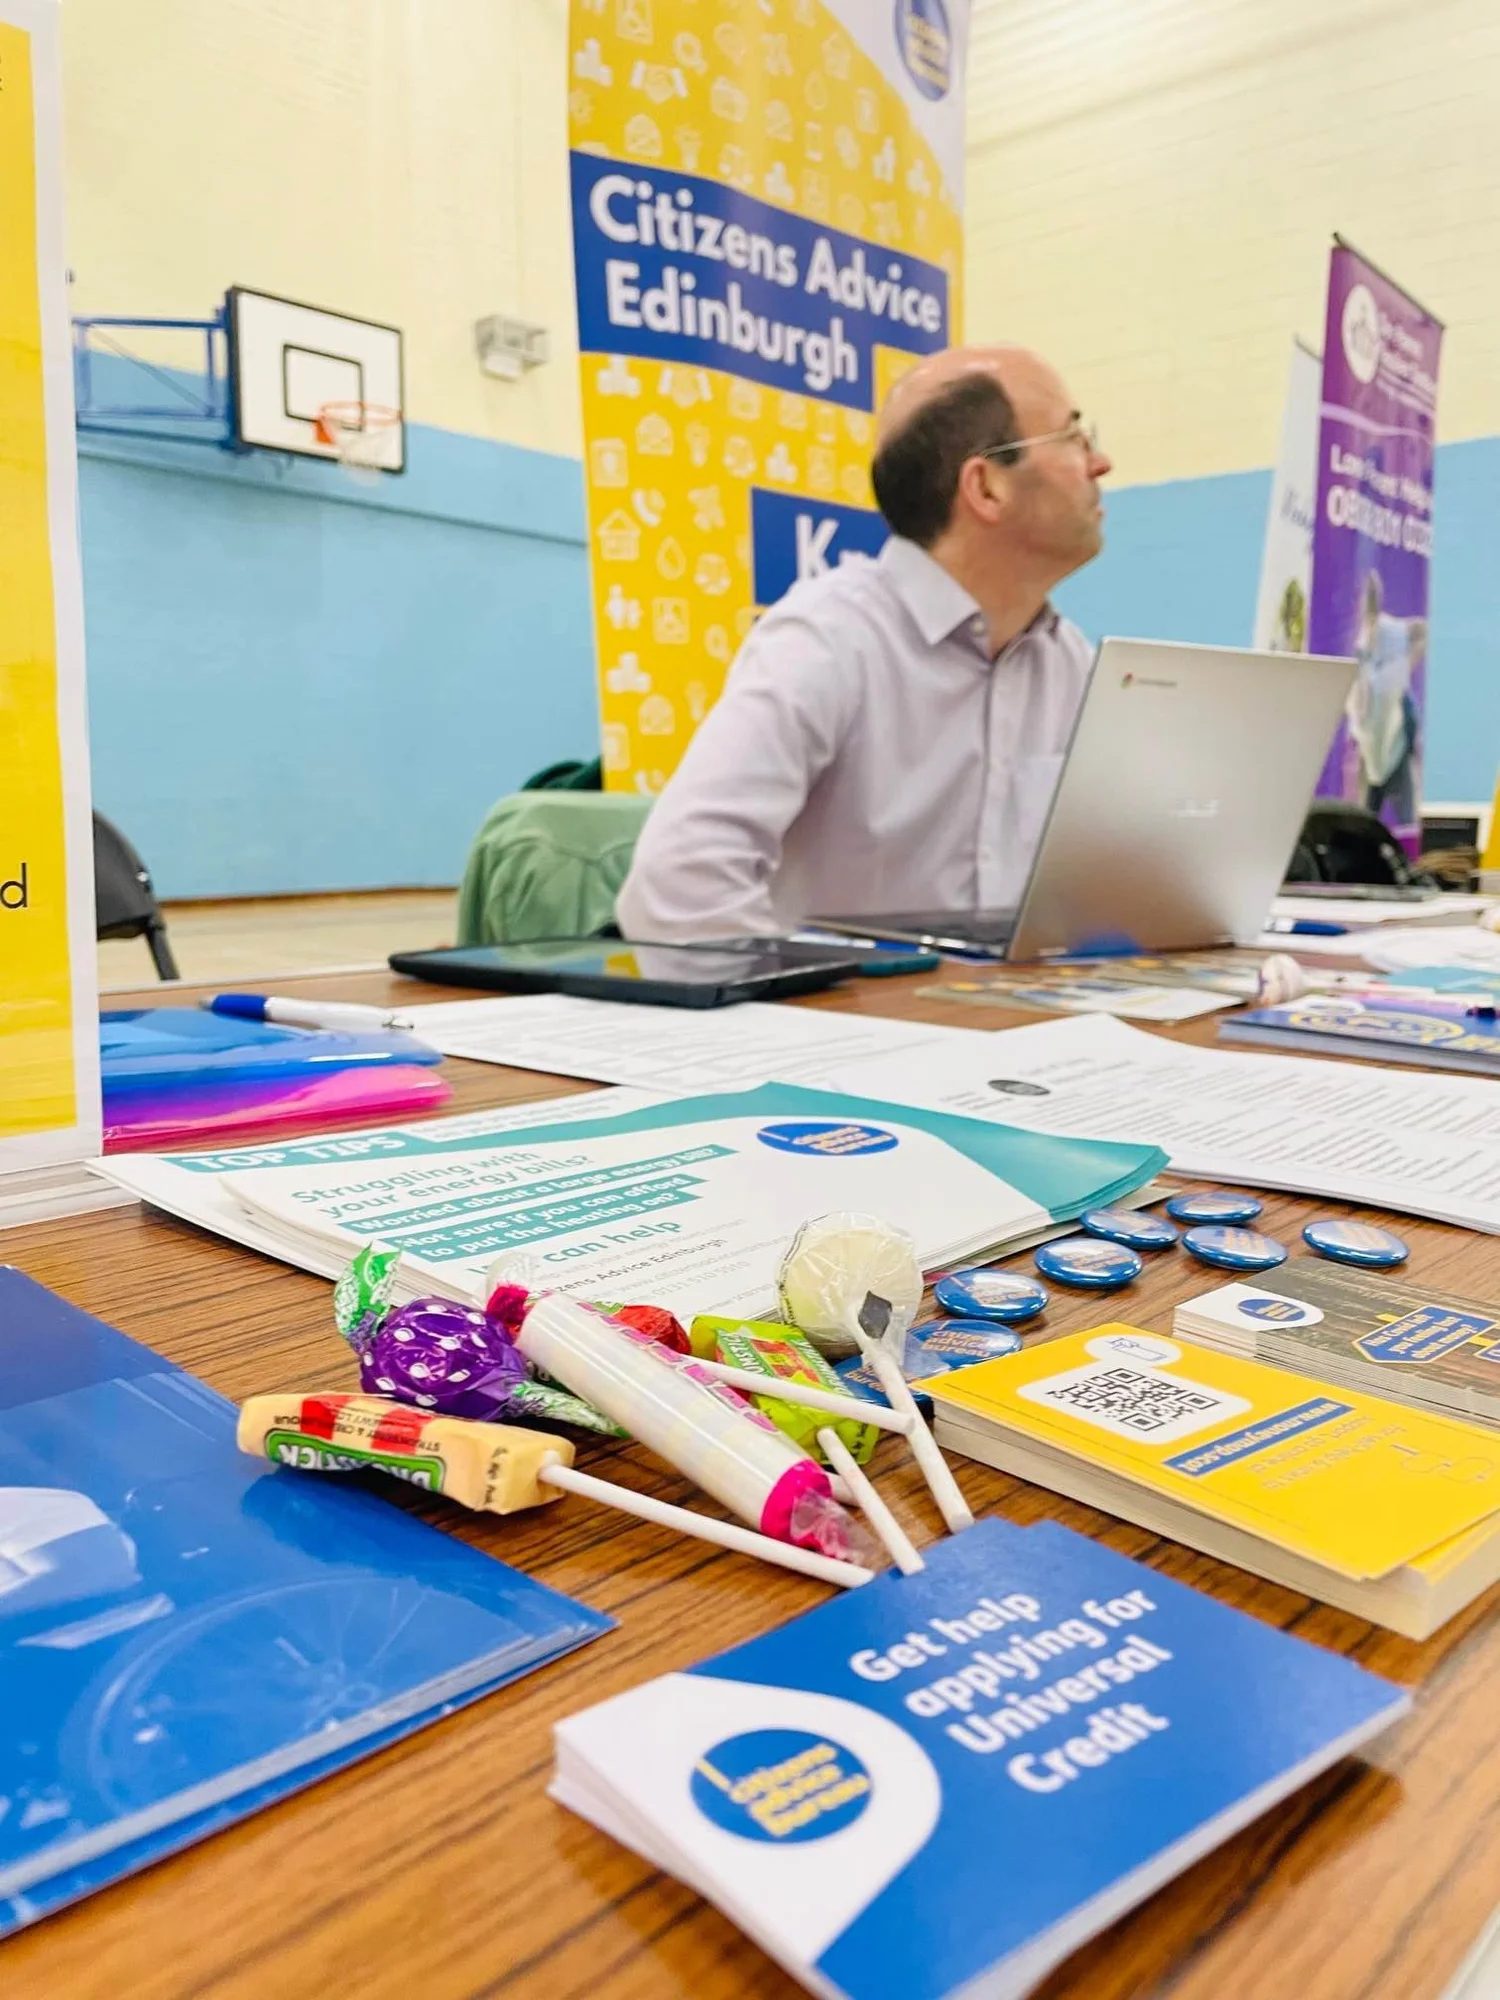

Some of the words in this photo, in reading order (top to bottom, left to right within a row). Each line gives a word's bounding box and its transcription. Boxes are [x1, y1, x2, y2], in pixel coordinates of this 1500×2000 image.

[590, 174, 797, 286] Citizens
[805, 238, 941, 332] Advice
[605, 260, 858, 390] Edinburgh
[182, 1150, 287, 1170] TOP
[287, 1135, 406, 1160] TIPS
[291, 1160, 474, 1204] Struggling
[470, 1151, 542, 1168] with
[319, 1190, 400, 1219] your
[406, 1171, 519, 1198] energy
[514, 1154, 594, 1175] bills?
[352, 1200, 458, 1230] Worried
[460, 1187, 537, 1211] about
[535, 1184, 551, 1194] a
[549, 1170, 612, 1192] large
[611, 1157, 682, 1177] energy
[397, 1226, 450, 1248] Not
[450, 1219, 510, 1238] sure
[509, 1209, 534, 1224] if
[533, 1202, 581, 1222] you
[580, 1193, 625, 1207] can
[623, 1176, 692, 1197] afford
[420, 1239, 454, 1257] to
[457, 1234, 508, 1254] put
[504, 1222, 553, 1241] the
[554, 1201, 646, 1229] heating
[641, 1190, 681, 1206] on?
[543, 1241, 608, 1262] can
[600, 1221, 682, 1244] help
[596, 1260, 652, 1281] Advice
[649, 1238, 728, 1263] Edinburgh
[278, 1444, 432, 1490] DSTICK
[848, 1631, 947, 1682] Get
[938, 1589, 1040, 1642] help
[905, 1613, 1107, 1717] applying
[1080, 1587, 1158, 1629] for
[945, 1635, 1173, 1755] Universal
[1006, 1700, 1171, 1794] Credit
